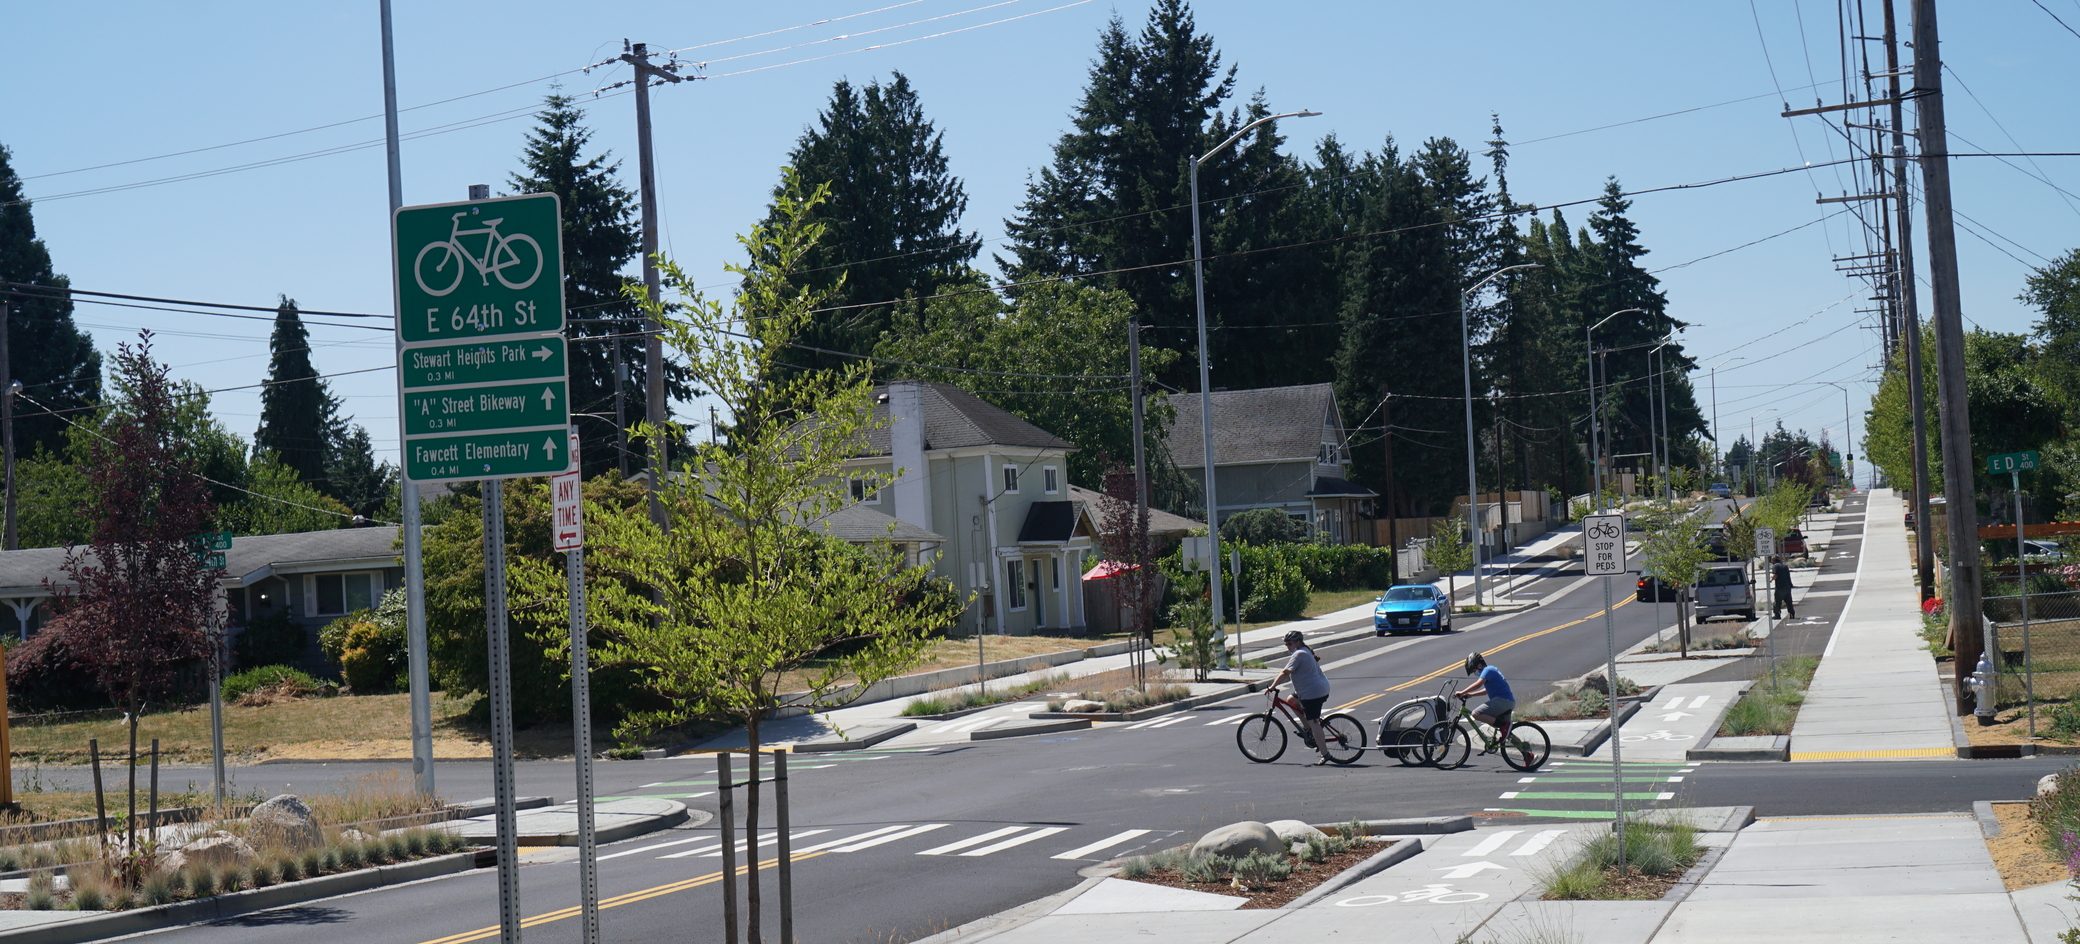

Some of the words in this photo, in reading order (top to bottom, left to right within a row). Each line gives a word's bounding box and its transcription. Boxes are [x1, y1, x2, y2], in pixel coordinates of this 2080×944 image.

[427, 308, 440, 333] E
[451, 303, 503, 331] 64th
[515, 300, 537, 325] St
[413, 351, 451, 369] Stewart
[457, 347, 496, 370] Heights
[502, 344, 526, 362] Park
[427, 372, 441, 382] 0.3
[445, 371, 454, 380] MI
[413, 399, 436, 416] "A"
[442, 395, 474, 414] Street
[480, 394, 526, 413] Bikeway
[429, 419, 443, 428] 0.3
[447, 418, 456, 427] MI
[416, 444, 459, 463] Fawcett
[465, 442, 530, 461] Elementary
[1993, 459, 2000, 470] E
[2005, 456, 2014, 470] D
[2020, 461, 2033, 469] 400
[431, 467, 445, 476] 0.4
[449, 466, 459, 475] MI
[558, 479, 574, 502] ANY
[557, 505, 577, 527] TIME
[1595, 542, 1614, 550] STOP
[1597, 552, 1613, 561] FOR
[1595, 562, 1616, 570] PEDS
